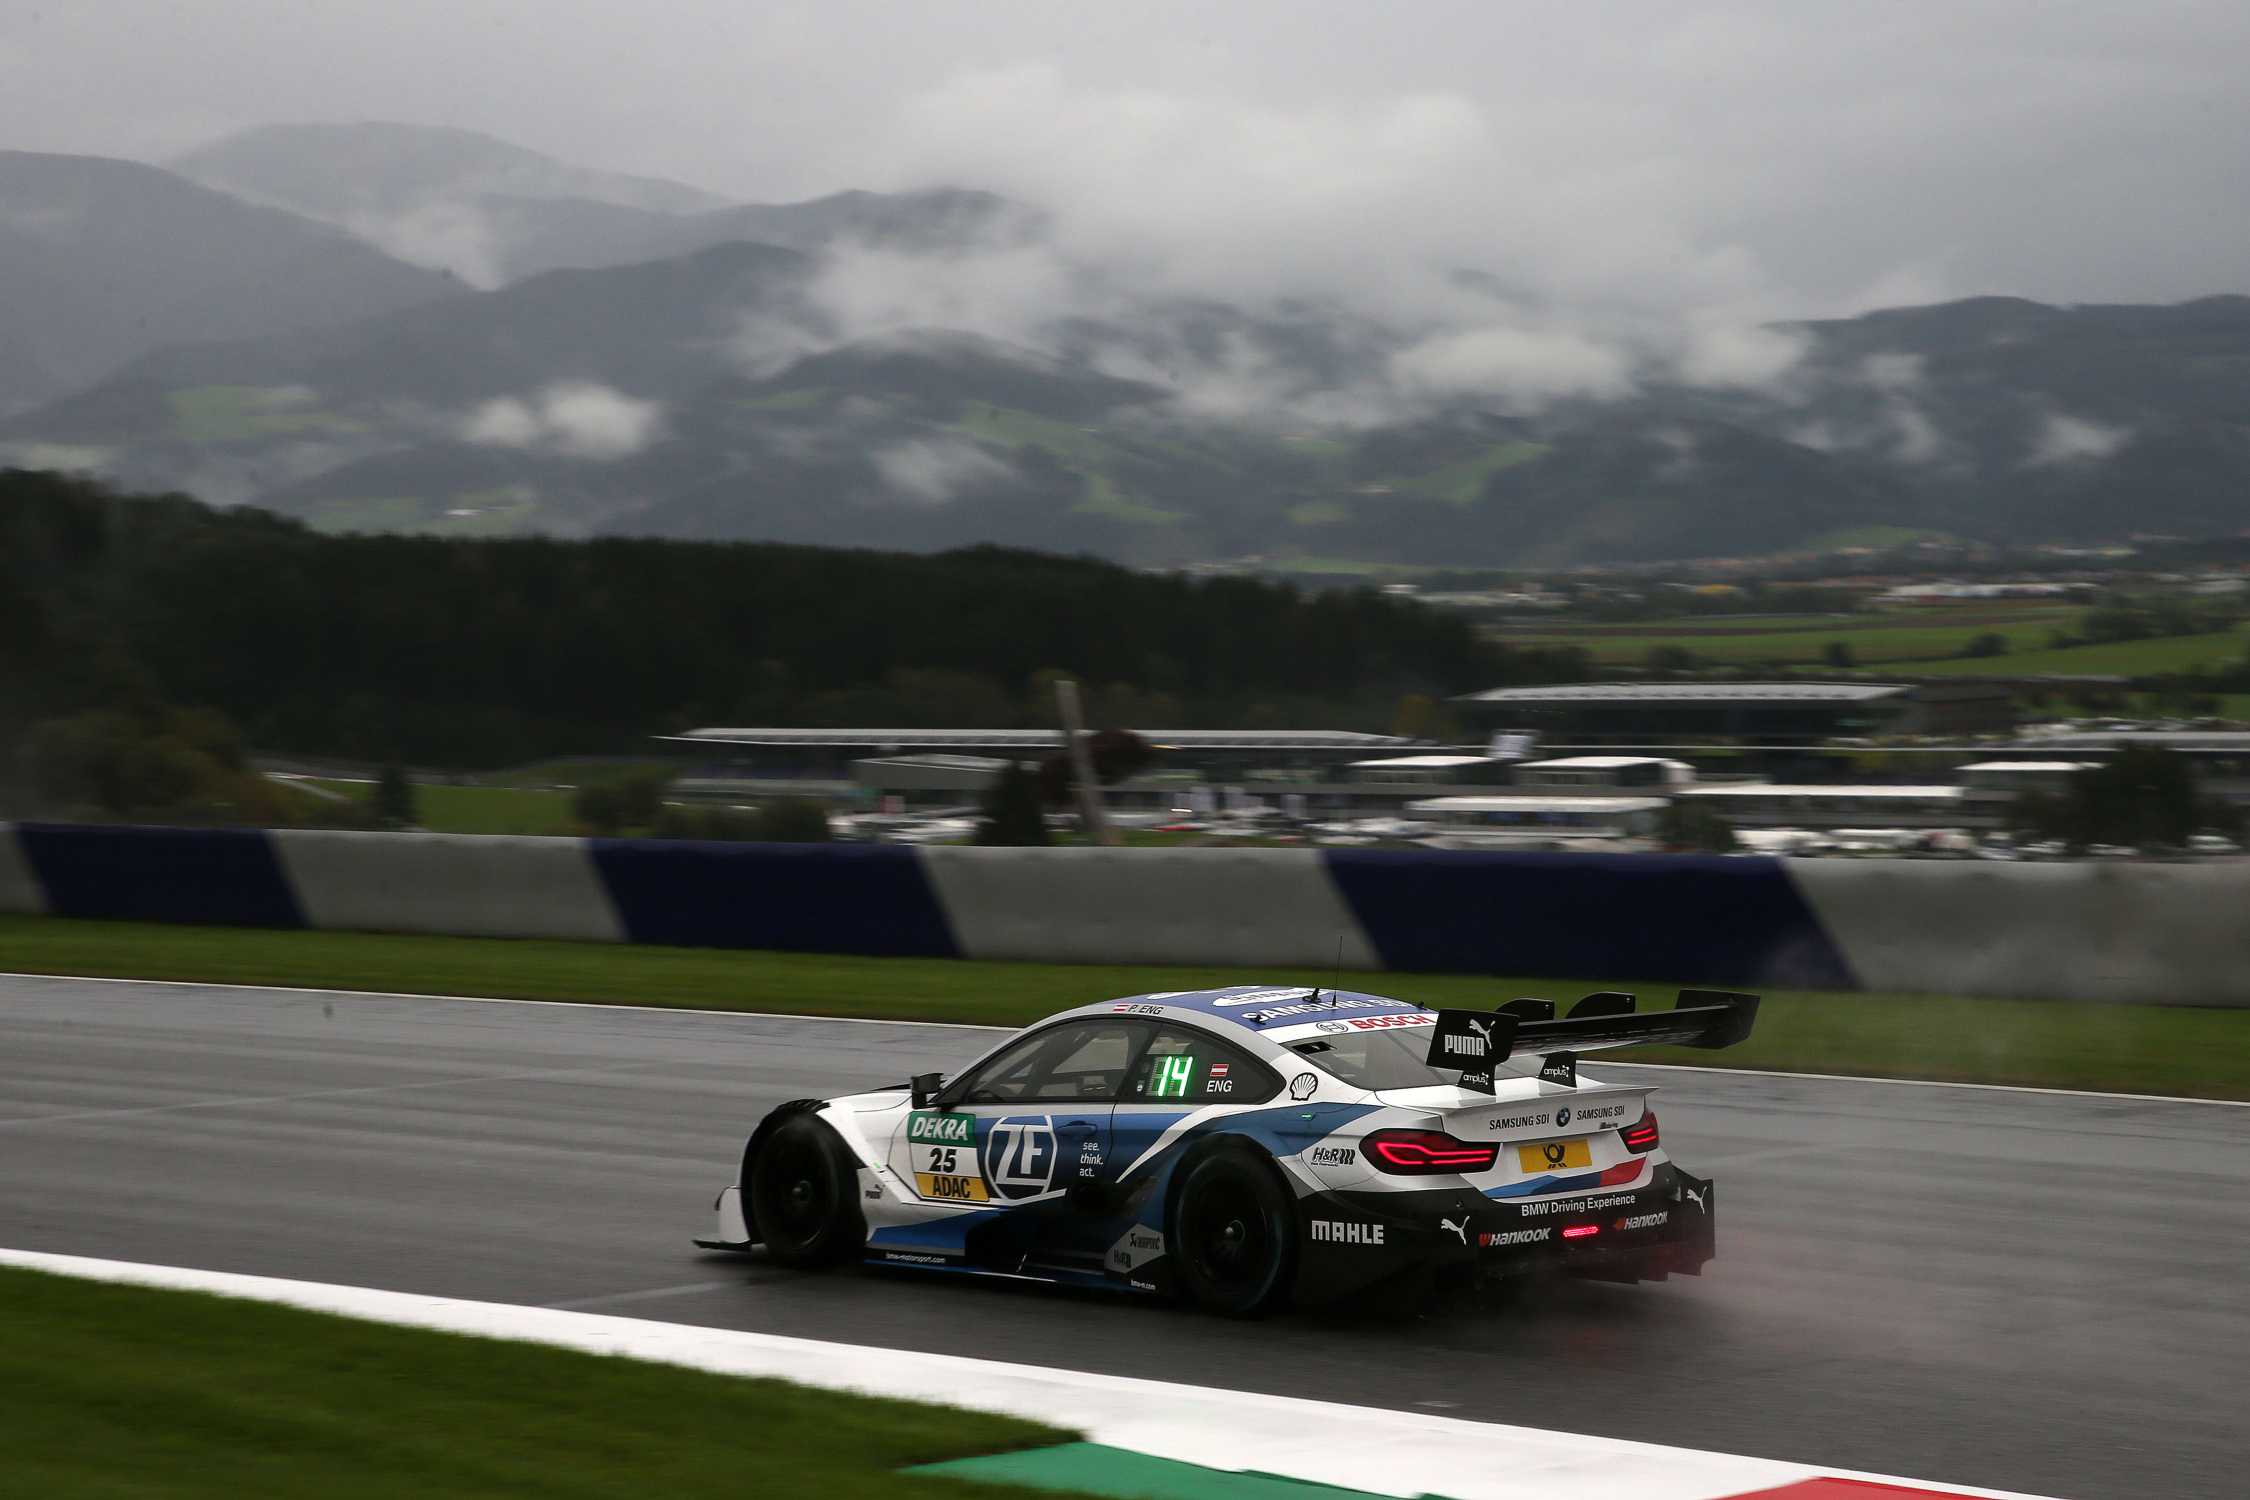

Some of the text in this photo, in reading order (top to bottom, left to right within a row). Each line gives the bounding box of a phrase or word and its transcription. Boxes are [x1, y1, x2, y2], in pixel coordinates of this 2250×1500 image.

[1128, 1004, 1164, 1015] P. ENG
[1349, 1014, 1433, 1030] BOSCH
[1444, 1034, 1485, 1056] PUMA
[1157, 1056, 1193, 1097] 14
[1463, 1072, 1486, 1084] amplus
[1543, 1066, 1567, 1077] amplus
[1206, 1080, 1232, 1093] ENG
[1489, 1113, 1549, 1130] SAMSUNG SDI
[1577, 1105, 1625, 1120] SAMSUNG SDI
[911, 1117, 968, 1141] DEKRA
[928, 1147, 957, 1173] 25
[994, 1124, 1050, 1186] ZF
[932, 1177, 970, 1198] ADAC
[1521, 1194, 1636, 1217] BMW Driving Experience
[1311, 1220, 1384, 1245] MAHLE
